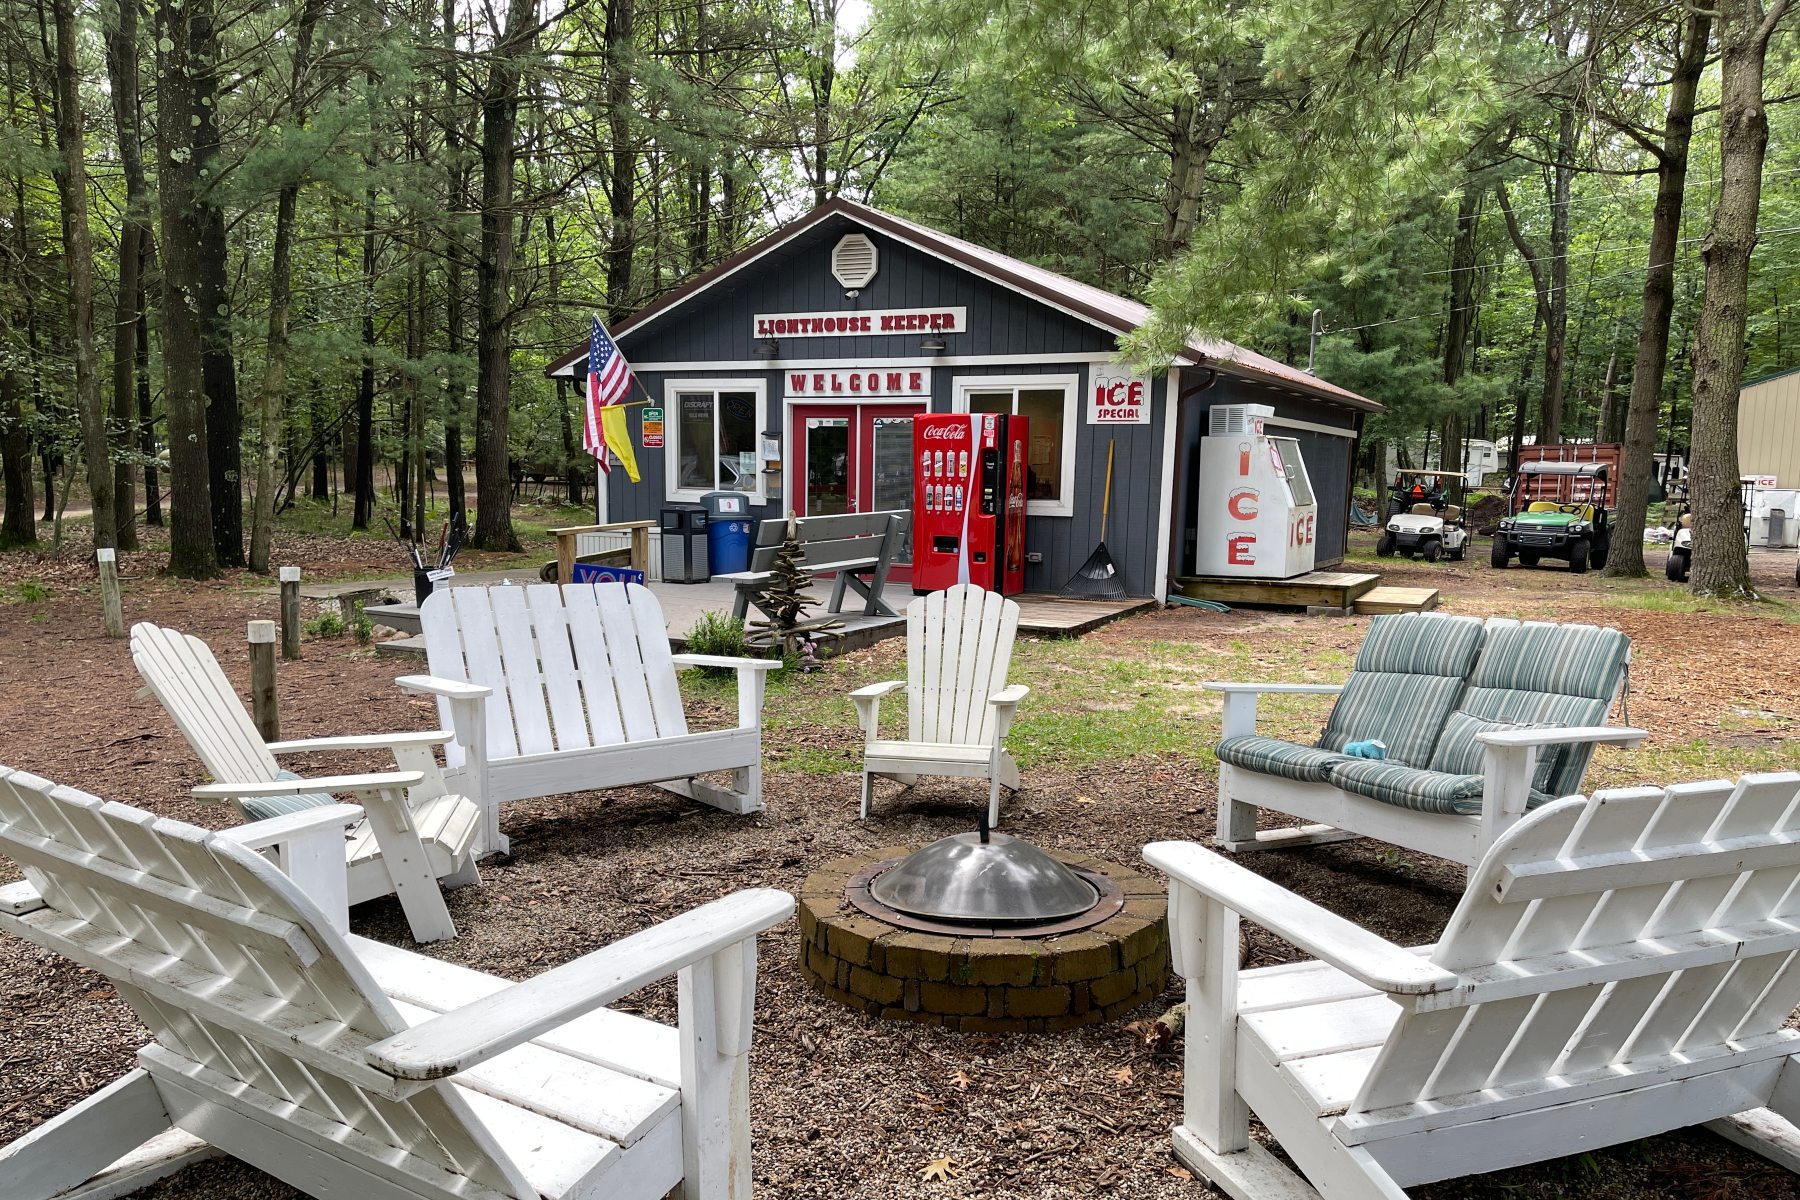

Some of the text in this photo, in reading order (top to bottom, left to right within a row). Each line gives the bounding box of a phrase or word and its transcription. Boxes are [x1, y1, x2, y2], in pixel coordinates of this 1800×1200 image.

[758, 313, 955, 335] LIGHTHOUSE KEEPER
[791, 373, 921, 392] WELCOME
[1095, 376, 1145, 406] ICE
[684, 401, 714, 409] DISCRAFT
[1097, 408, 1140, 418] SPECIAL
[923, 423, 968, 440] Coca-Cola
[1290, 511, 1315, 548] ICE
